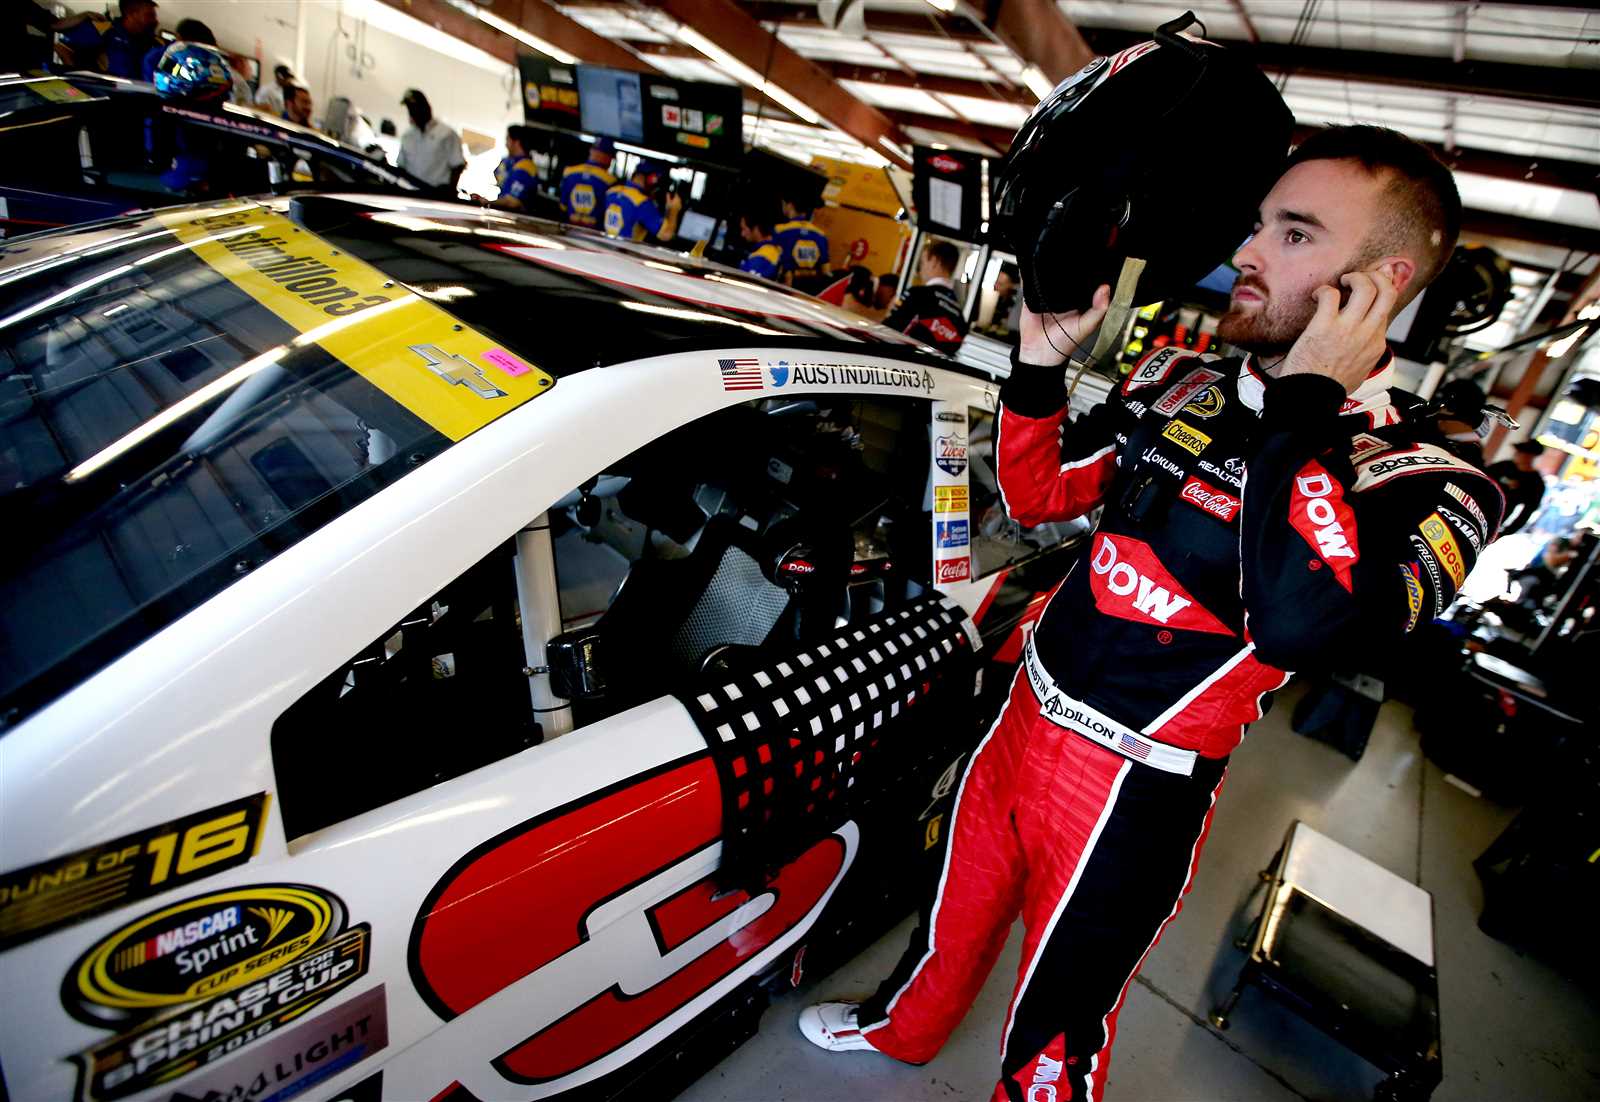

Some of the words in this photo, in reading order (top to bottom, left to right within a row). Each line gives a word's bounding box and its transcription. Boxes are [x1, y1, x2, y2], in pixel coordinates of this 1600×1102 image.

[1167, 424, 1207, 453] Cheerios
[1151, 454, 1185, 480] OKUMA
[1368, 455, 1454, 477] sparco
[1181, 482, 1241, 519] Coca-Cola
[1296, 473, 1356, 559] DOW
[788, 562, 815, 573] DOW
[1092, 536, 1192, 624] DOW
[1063, 706, 1116, 741] DILLON
[96, 845, 141, 871] OF
[146, 810, 249, 886] 16
[156, 906, 239, 957] NASCAR
[175, 924, 259, 975] Sprint
[195, 966, 239, 996] CUP
[245, 936, 312, 969] SERIES
[278, 958, 354, 1004] CUP
[300, 949, 335, 969] FOR
[130, 967, 294, 1058] CHASE
[275, 1015, 373, 1082] LIGHT
[1027, 1053, 1063, 1102] OW
